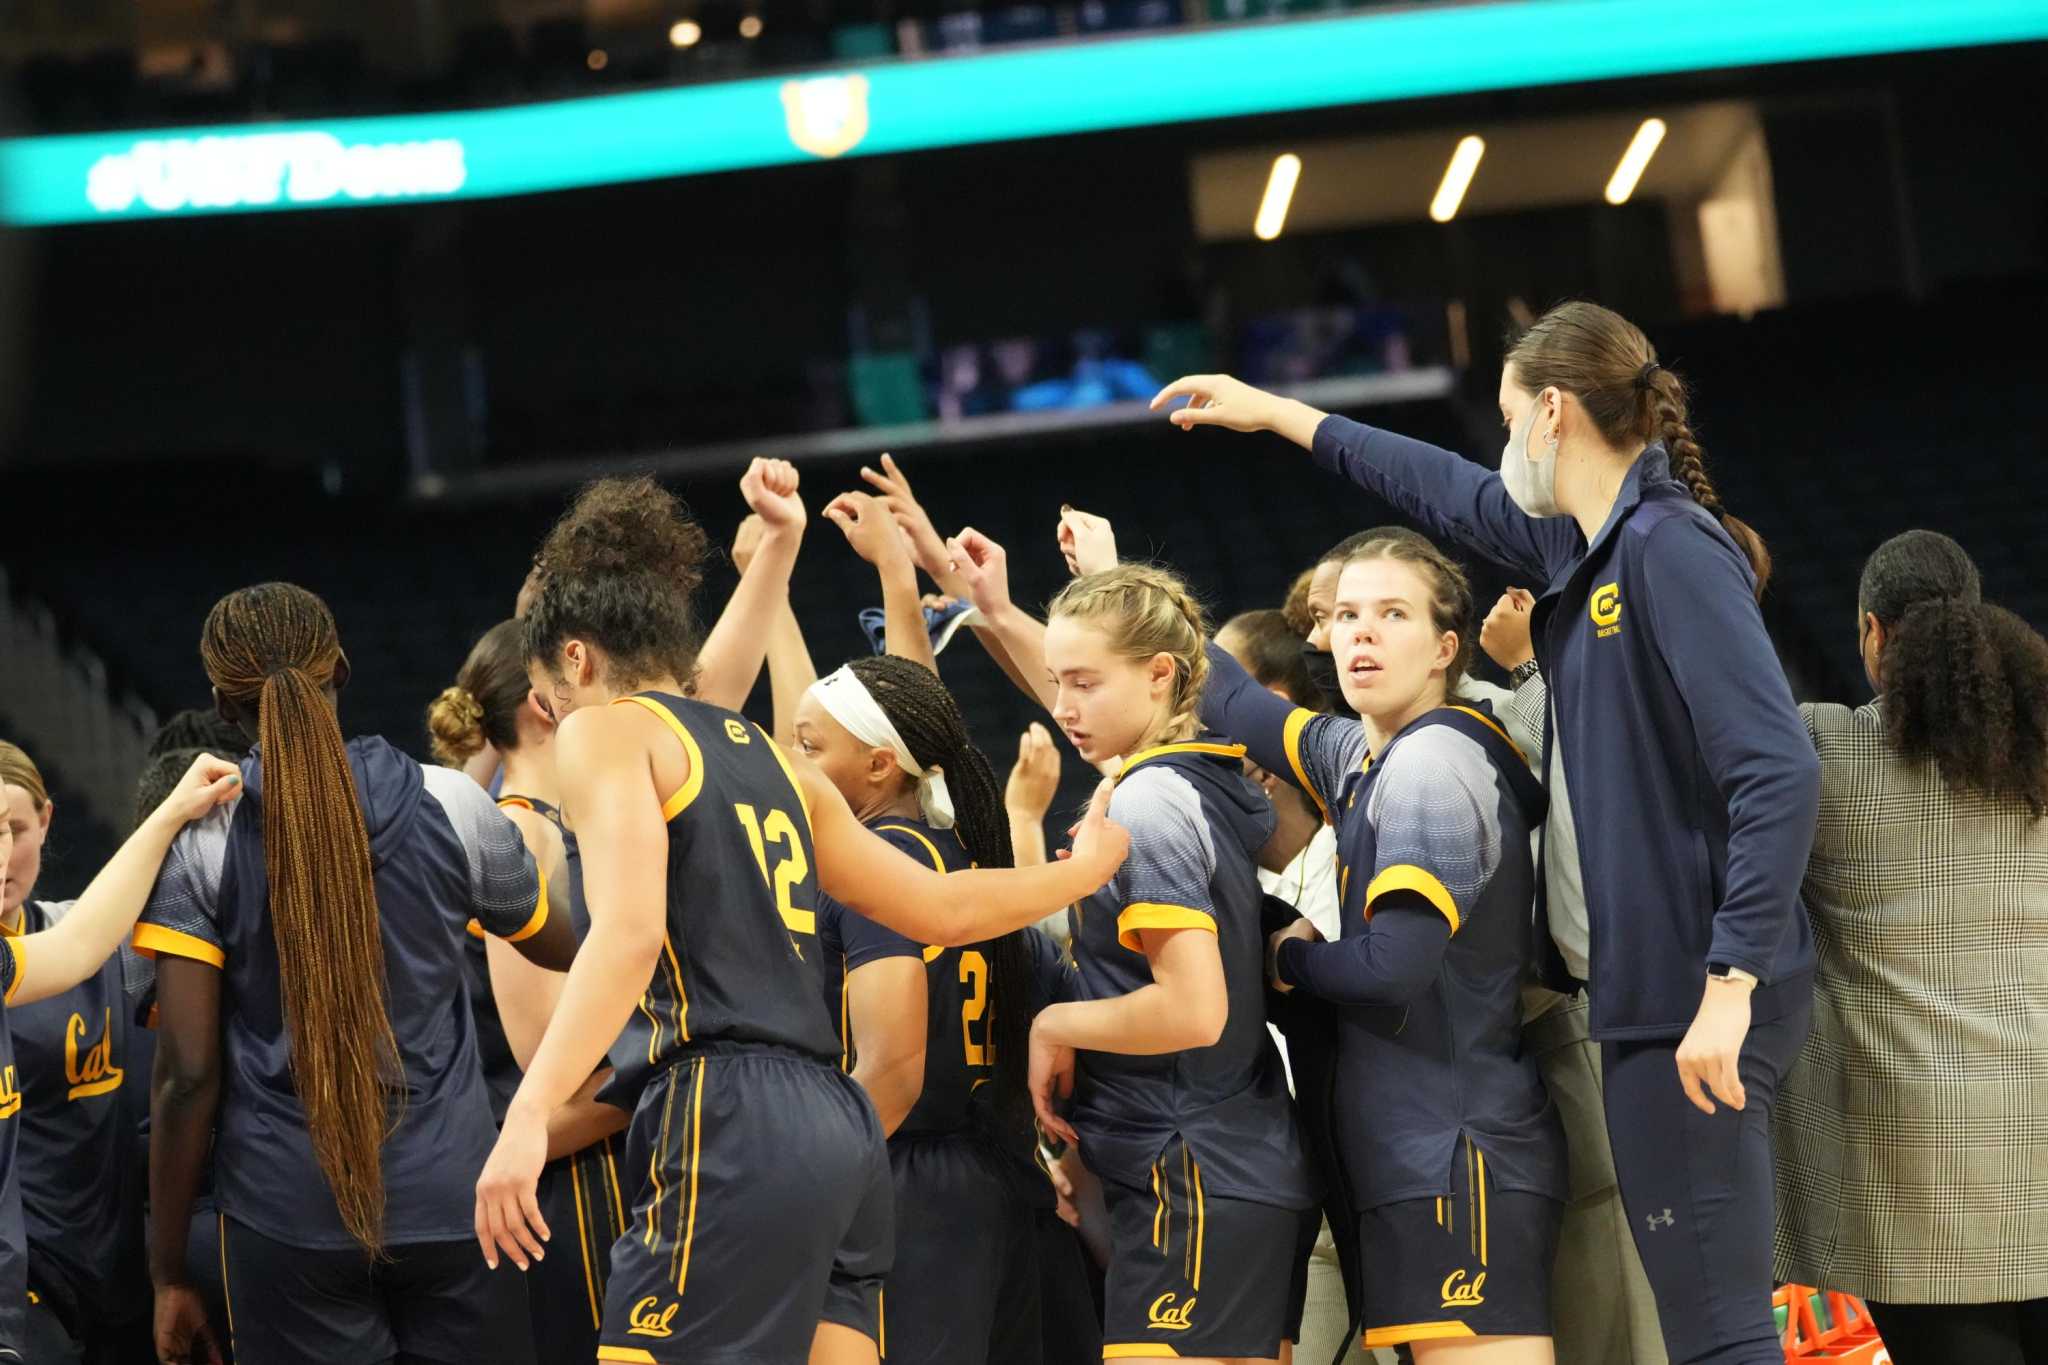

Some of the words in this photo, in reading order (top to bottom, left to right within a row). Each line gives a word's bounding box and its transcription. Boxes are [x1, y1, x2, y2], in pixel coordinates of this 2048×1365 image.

[734, 803, 816, 935] 12
[65, 1007, 124, 1101] Cal
[1441, 1269, 1487, 1309] Cal
[627, 1296, 679, 1337] Cal
[1147, 1292, 1197, 1330] Cal
